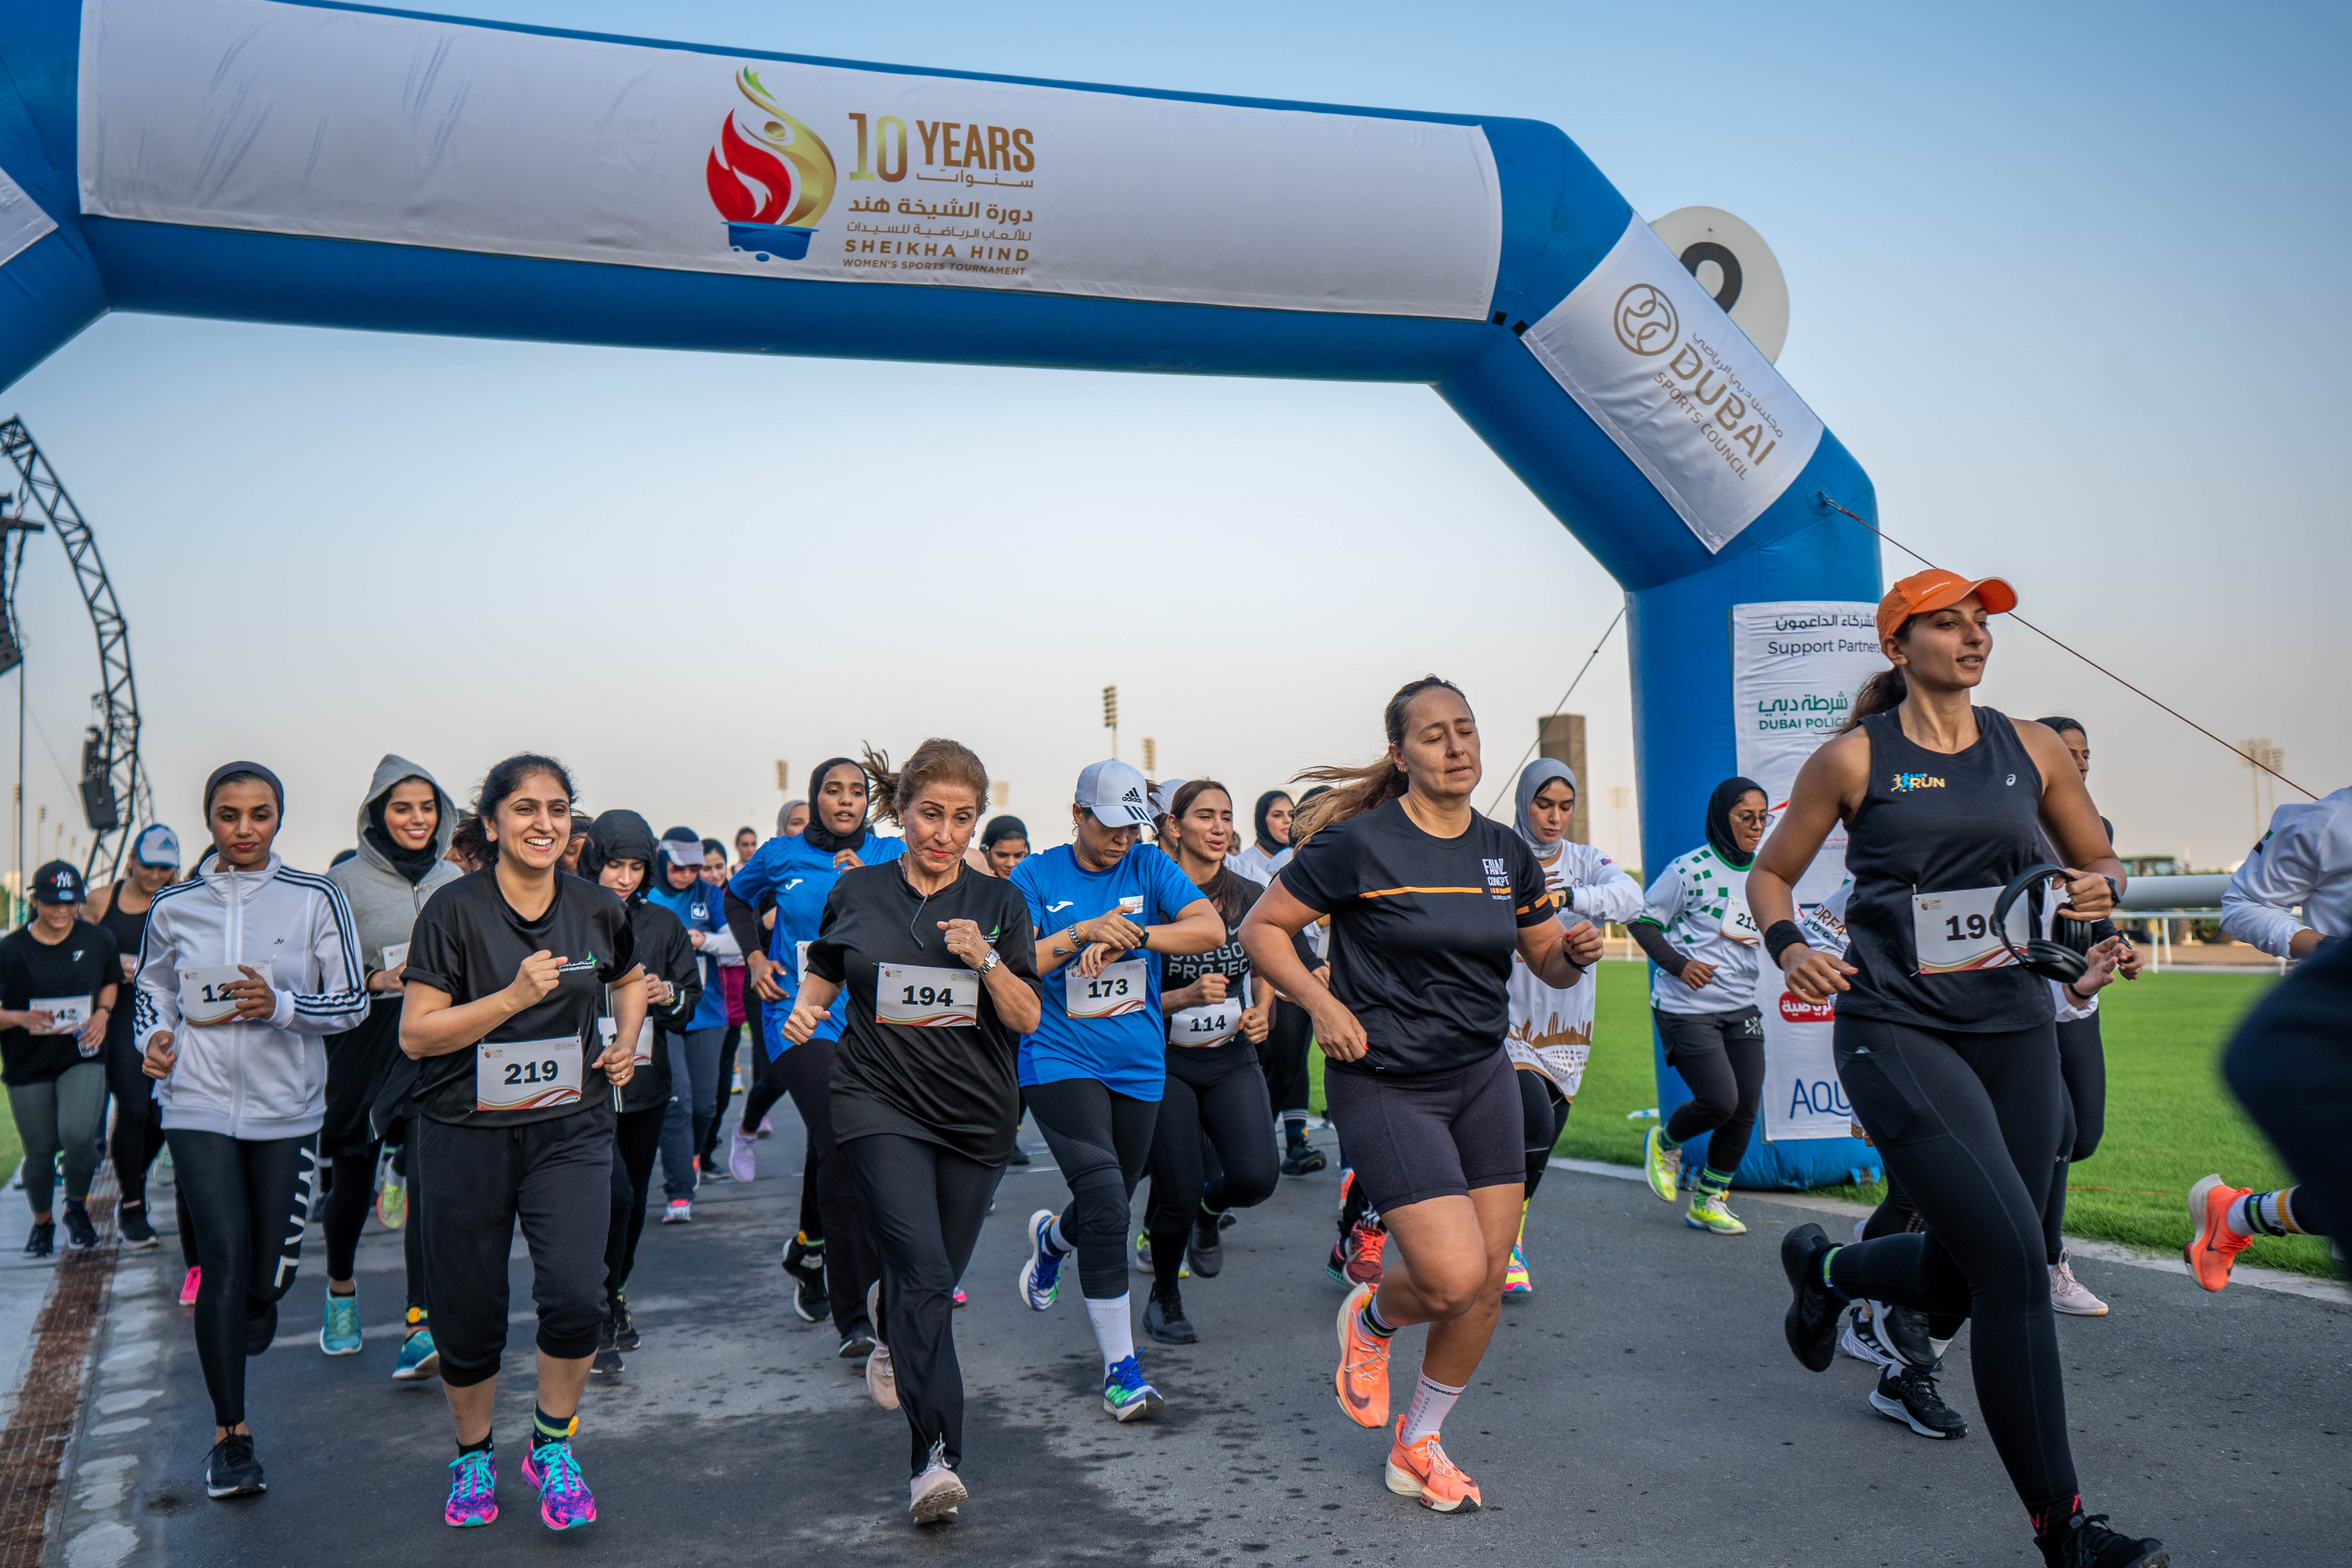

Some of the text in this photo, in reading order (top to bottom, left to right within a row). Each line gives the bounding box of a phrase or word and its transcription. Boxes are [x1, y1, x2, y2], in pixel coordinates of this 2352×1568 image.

[848, 112, 1035, 182] 10 YEARS
[916, 169, 1034, 188] سنوات
[848, 196, 1033, 225] دورة الشيخة هند
[846, 221, 910, 234] للسيدات
[913, 223, 979, 240] الرياضية
[844, 239, 1029, 262] SHEIKHA HIND
[842, 258, 1026, 276] WOMEN'S SPORTS TOURNAMENT
[1728, 373, 1752, 399] دبي
[1669, 342, 1777, 466] DUBAI
[1653, 372, 1748, 481] SPORTS COUNCIL
[1776, 614, 1838, 631] الداعمون
[1768, 639, 1880, 657] Support Partners
[1759, 691, 1848, 717] شرطة دبي
[1759, 719, 1802, 730] DUBAI
[1910, 777, 1945, 788] RUN
[902, 985, 953, 1007] 194
[1088, 978, 1129, 999] 173
[1190, 1014, 1227, 1032] 114
[504, 1060, 559, 1085] 219
